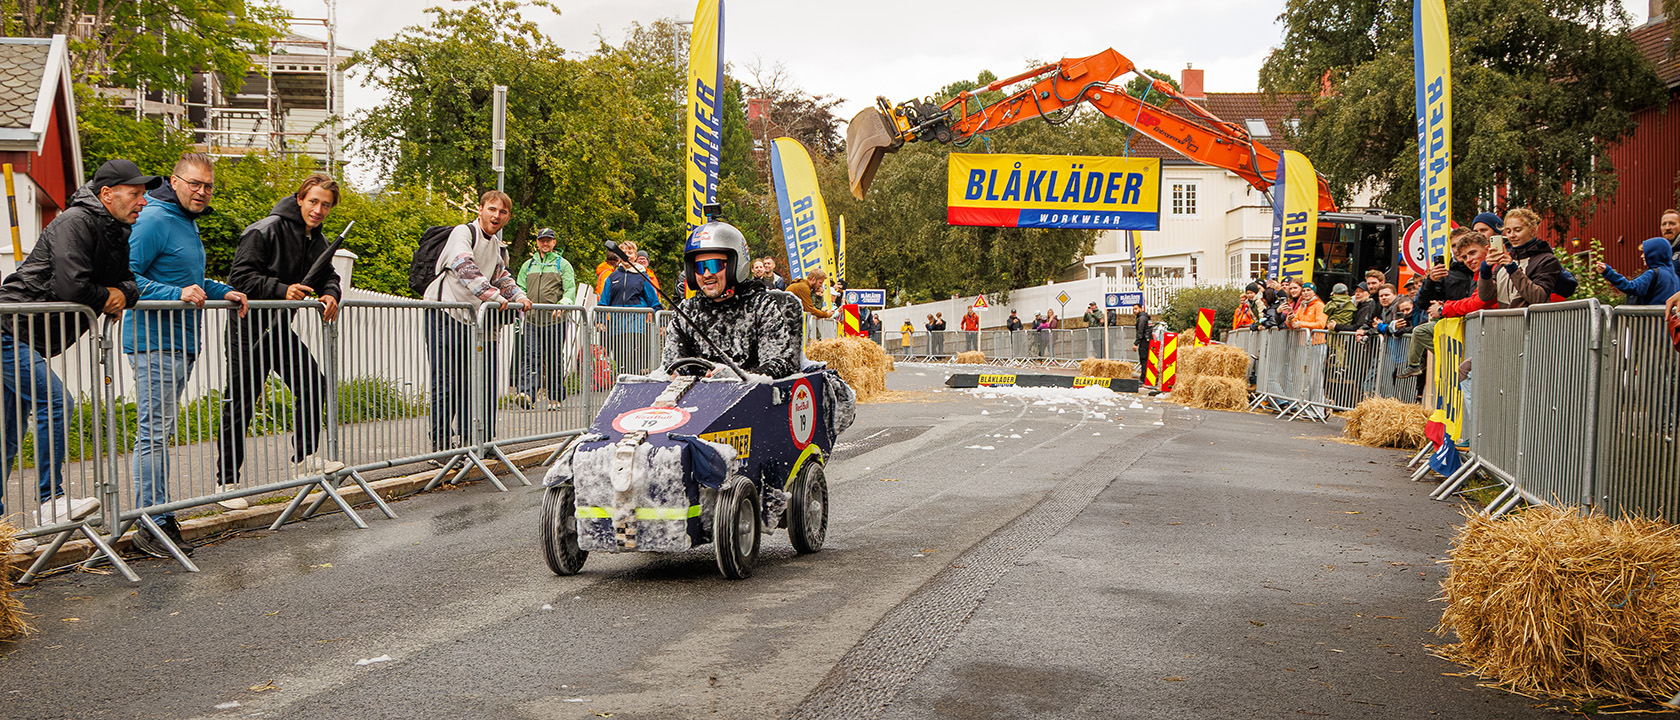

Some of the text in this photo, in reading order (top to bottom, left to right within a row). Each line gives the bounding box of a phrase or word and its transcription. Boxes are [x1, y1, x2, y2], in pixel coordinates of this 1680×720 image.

[709, 115, 720, 204] ORKWEAR
[965, 161, 1144, 205] BLÅKLÄDER
[1040, 213, 1121, 225] WORKWEAR
[800, 414, 806, 431] 19
